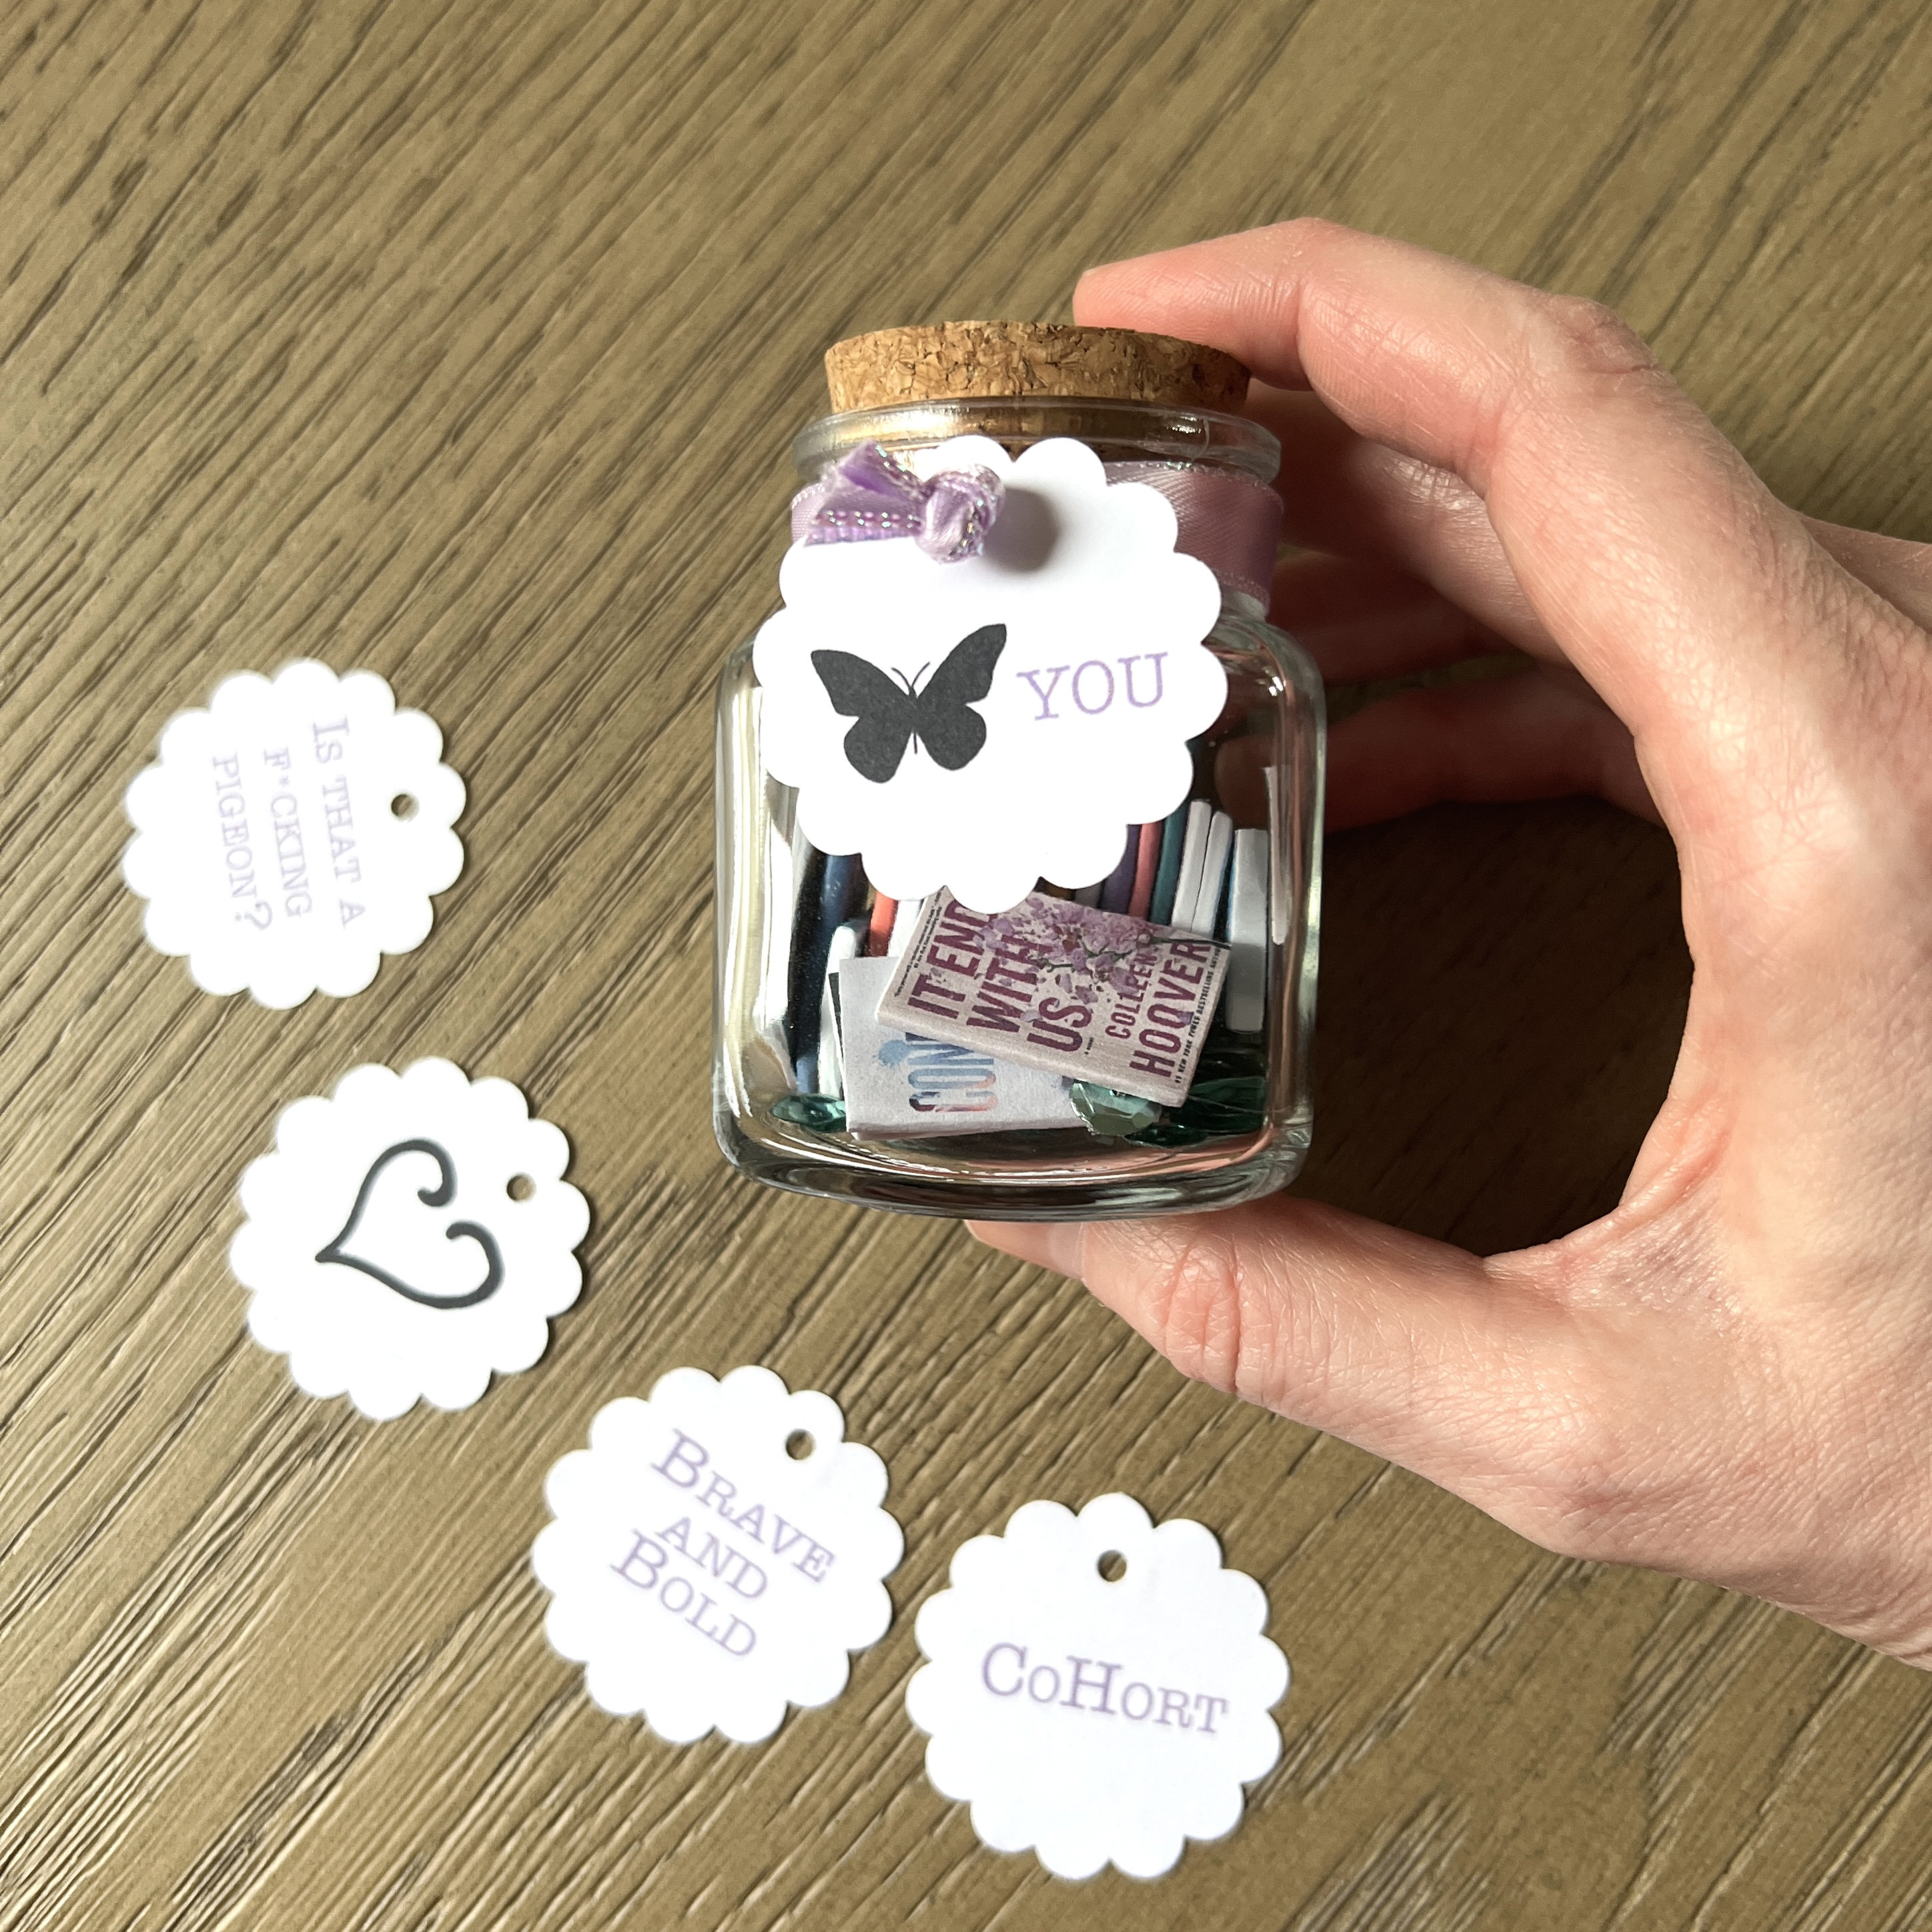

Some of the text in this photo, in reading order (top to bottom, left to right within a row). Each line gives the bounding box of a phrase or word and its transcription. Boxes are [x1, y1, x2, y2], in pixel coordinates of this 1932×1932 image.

[1016, 651, 1168, 720] YOU
[212, 752, 273, 931] PIGEON?
[312, 716, 366, 928] IS THAT A
[907, 973, 966, 1019] IT
[966, 934, 1053, 1033] WITH
[1026, 997, 1091, 1051] US
[1105, 953, 1157, 1039] COLLEEN
[1129, 942, 1211, 1078] HOOVER
[905, 1032, 998, 1112] CON
[650, 1428, 837, 1583] BRAVE
[610, 1528, 757, 1656] BOLD
[654, 1516, 768, 1599] AND
